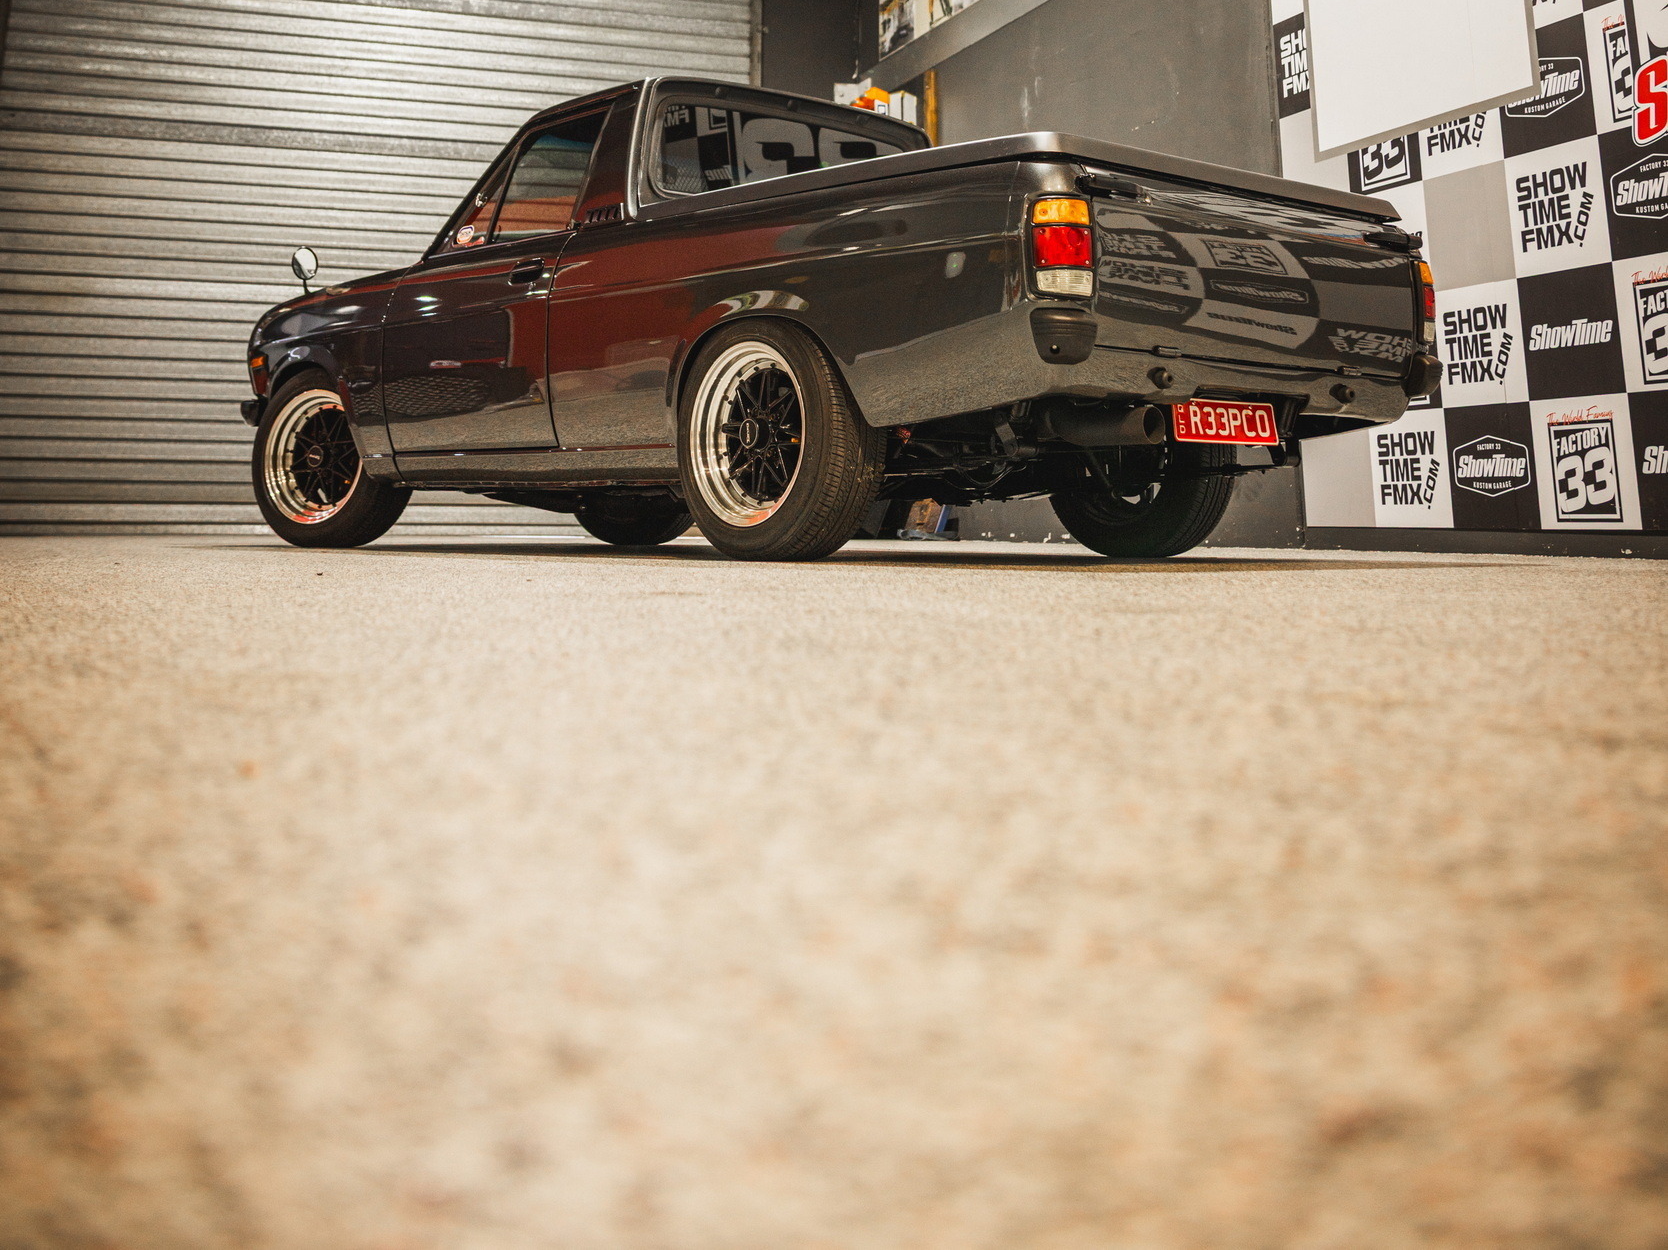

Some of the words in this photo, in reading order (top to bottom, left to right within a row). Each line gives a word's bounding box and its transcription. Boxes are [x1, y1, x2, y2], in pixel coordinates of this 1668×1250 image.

[1427, 124, 1472, 157] FMX
[1516, 161, 1587, 203] SHOW
[1640, 161, 1661, 172] FACTORY
[1518, 193, 1572, 228] TIME
[1574, 191, 1594, 248] .COM
[1635, 205, 1660, 214] KUSTOM
[1521, 220, 1574, 253] FMX
[1443, 303, 1507, 337] SHOW
[1529, 318, 1613, 351] ShowTime
[1445, 332, 1493, 362] TIME
[1494, 332, 1513, 385] .COM
[1447, 358, 1495, 385] FMX
[1561, 409, 1583, 426] World
[1586, 405, 1614, 423] Famous
[1377, 430, 1435, 457] SHOW
[1554, 426, 1608, 457] FACTORY
[1378, 458, 1422, 482] TIME
[1457, 454, 1526, 478] ShowTime
[1557, 446, 1615, 513] 33
[1380, 483, 1424, 505] FMX
[1423, 458, 1440, 510] .COM
[1473, 481, 1493, 490] KUSTOM
[1493, 480, 1512, 489] GARAGE
